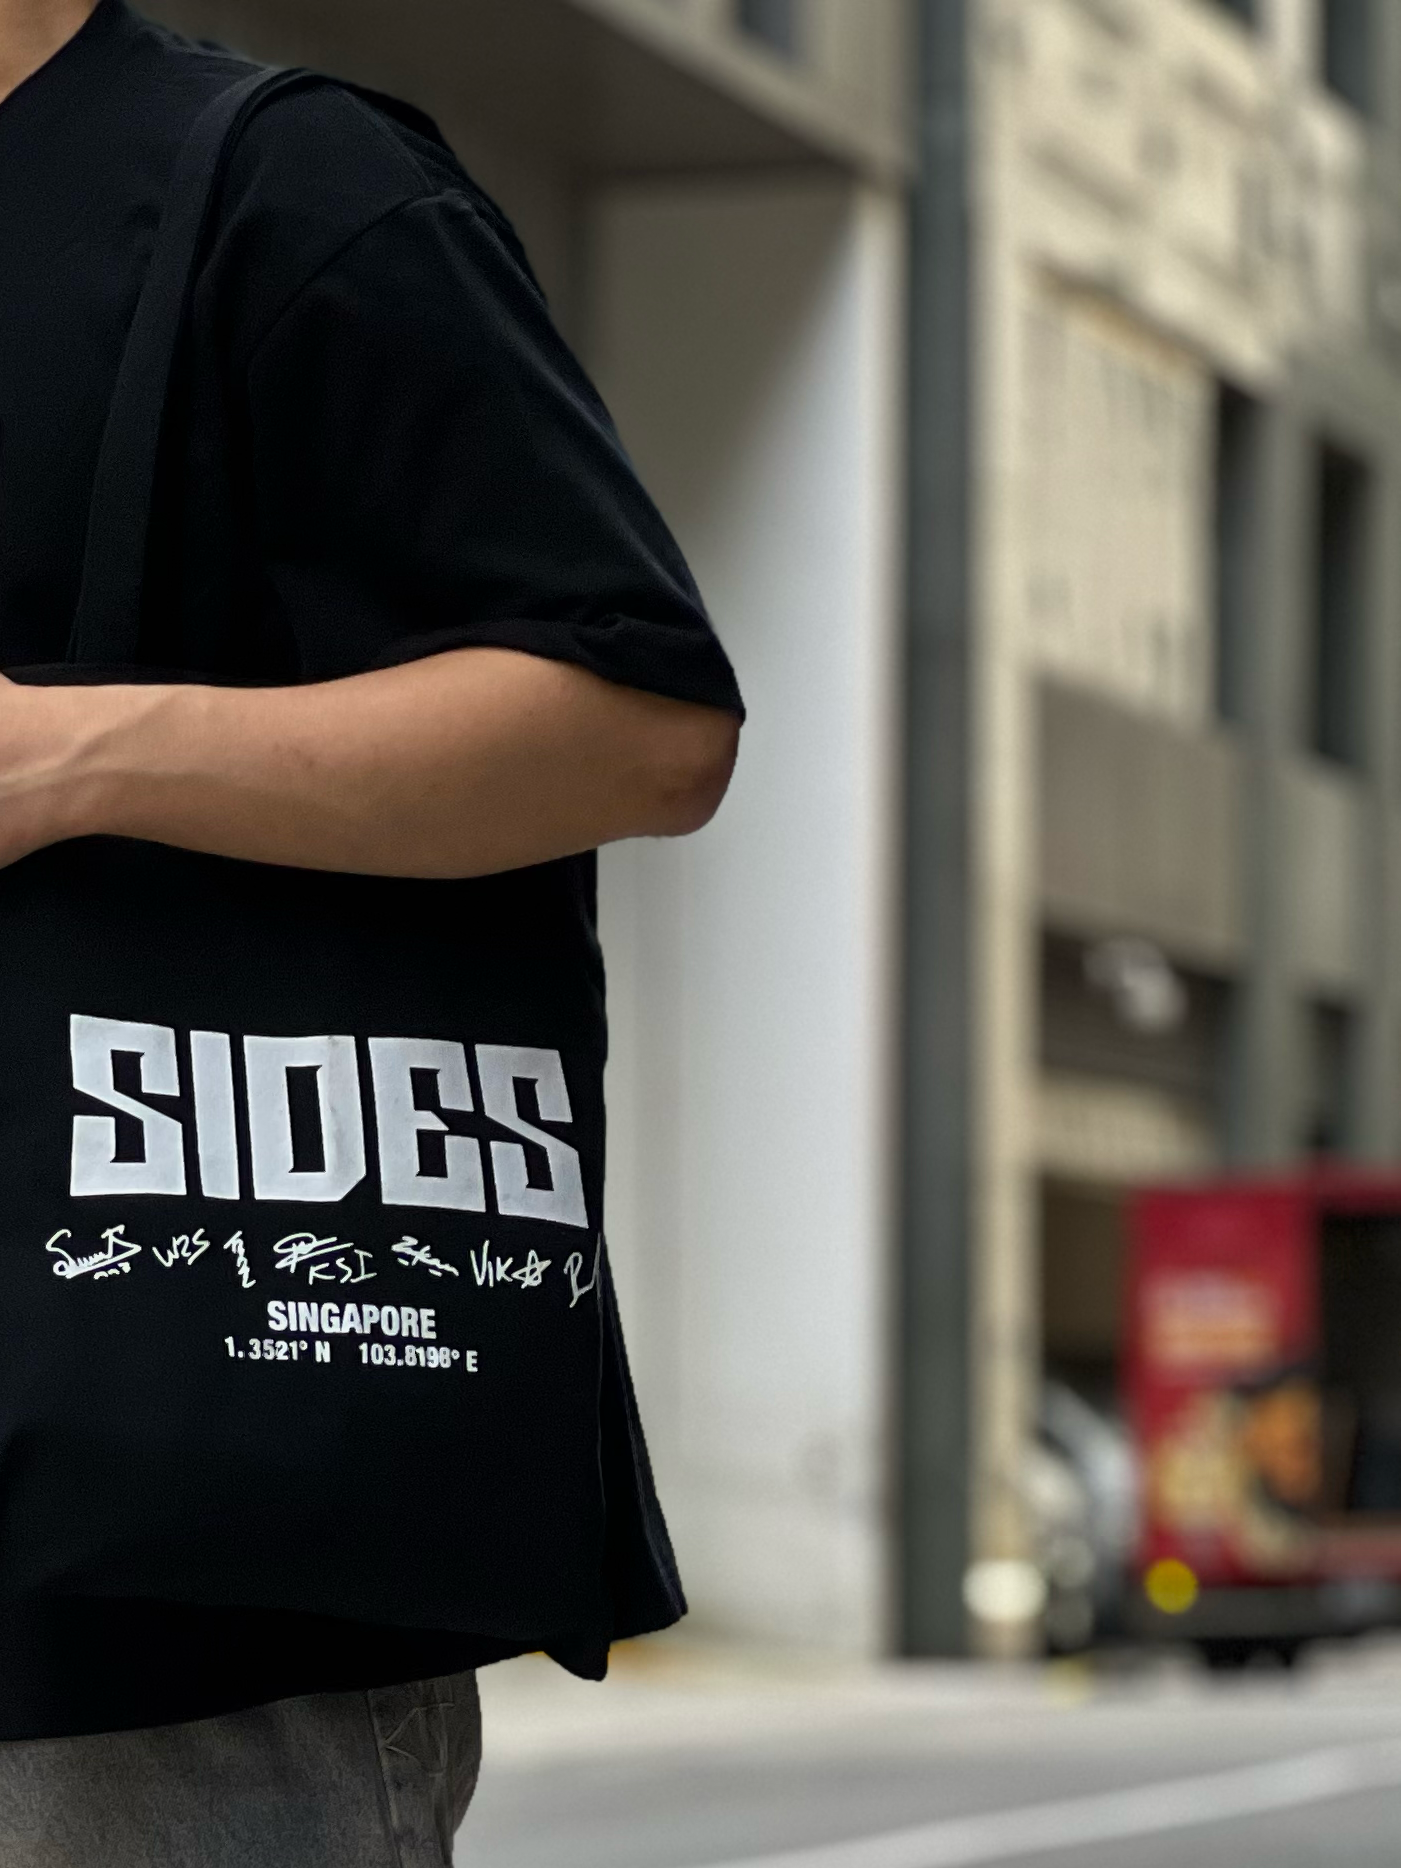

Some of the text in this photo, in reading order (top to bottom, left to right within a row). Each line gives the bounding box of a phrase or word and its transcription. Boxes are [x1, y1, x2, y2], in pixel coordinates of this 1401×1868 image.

[69, 1013, 590, 1229] SIDES
[266, 1300, 437, 1340] SINGAPORE
[314, 1340, 331, 1364] N
[465, 1349, 479, 1373] E
